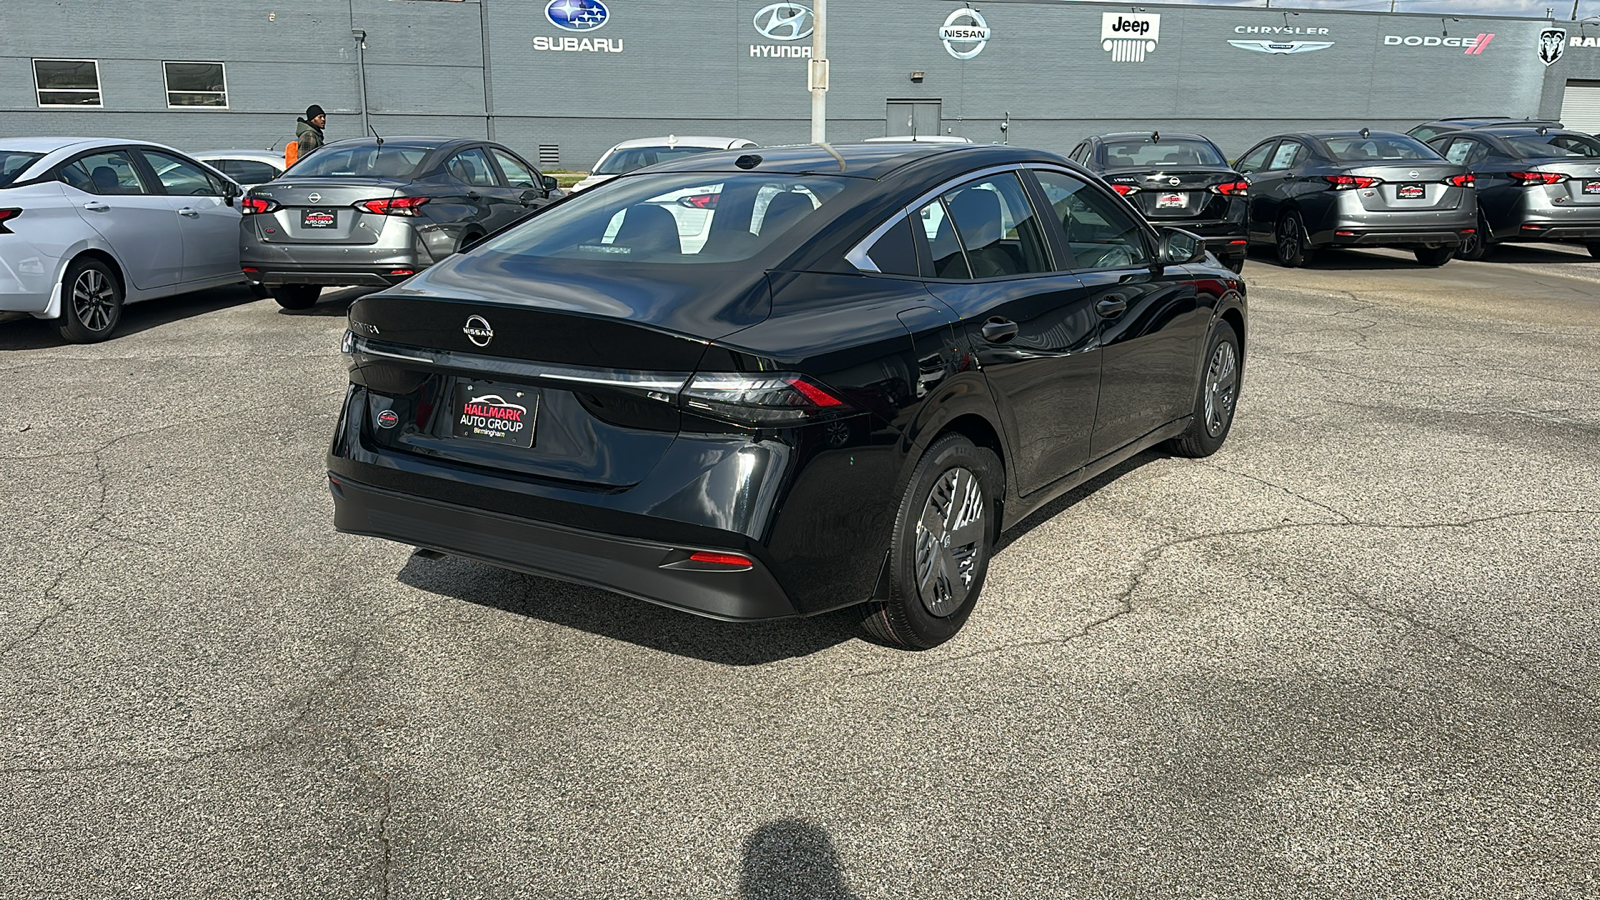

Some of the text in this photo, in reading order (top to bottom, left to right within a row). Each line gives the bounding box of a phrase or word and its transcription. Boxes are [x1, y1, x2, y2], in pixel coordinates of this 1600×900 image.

[1112, 16, 1150, 36] Jeep
[1234, 25, 1330, 36] CHRYSLER
[944, 29, 986, 38] NISSAN
[532, 36, 624, 53] SUBARU
[1384, 35, 1479, 47] DODGE
[1569, 36, 1600, 48] RA
[463, 327, 494, 337] NISSAN
[464, 403, 522, 422] HALLMARK
[460, 414, 524, 433] AUTO GROUP
[473, 427, 506, 438] Birmingham
